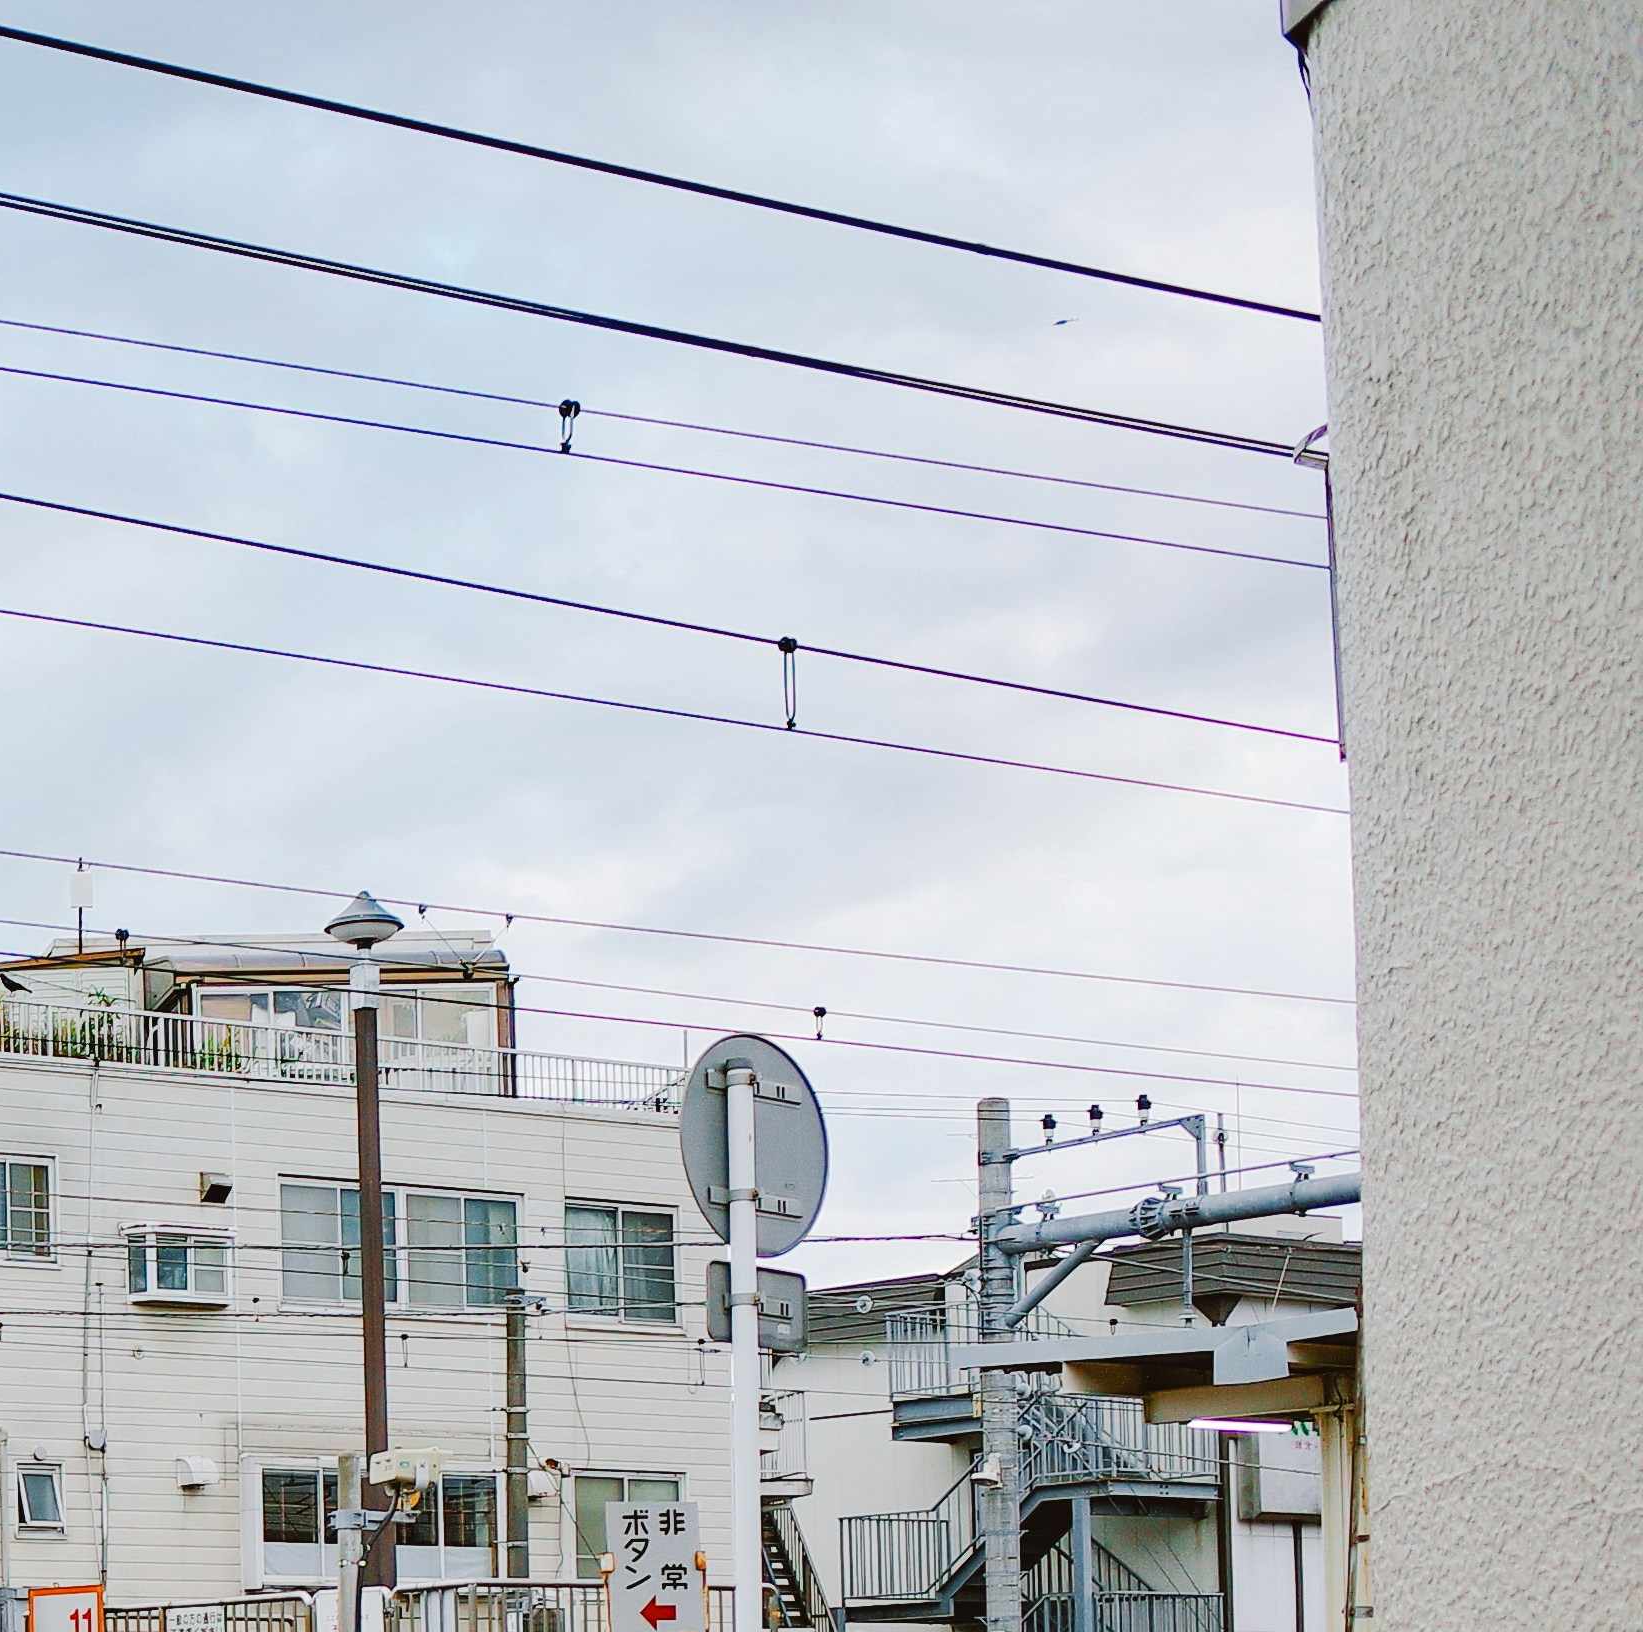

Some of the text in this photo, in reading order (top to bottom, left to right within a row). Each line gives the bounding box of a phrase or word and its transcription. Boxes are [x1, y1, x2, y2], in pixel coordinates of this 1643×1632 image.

[621, 1508, 652, 1590] ボタン
[658, 1508, 689, 1591] 非常
